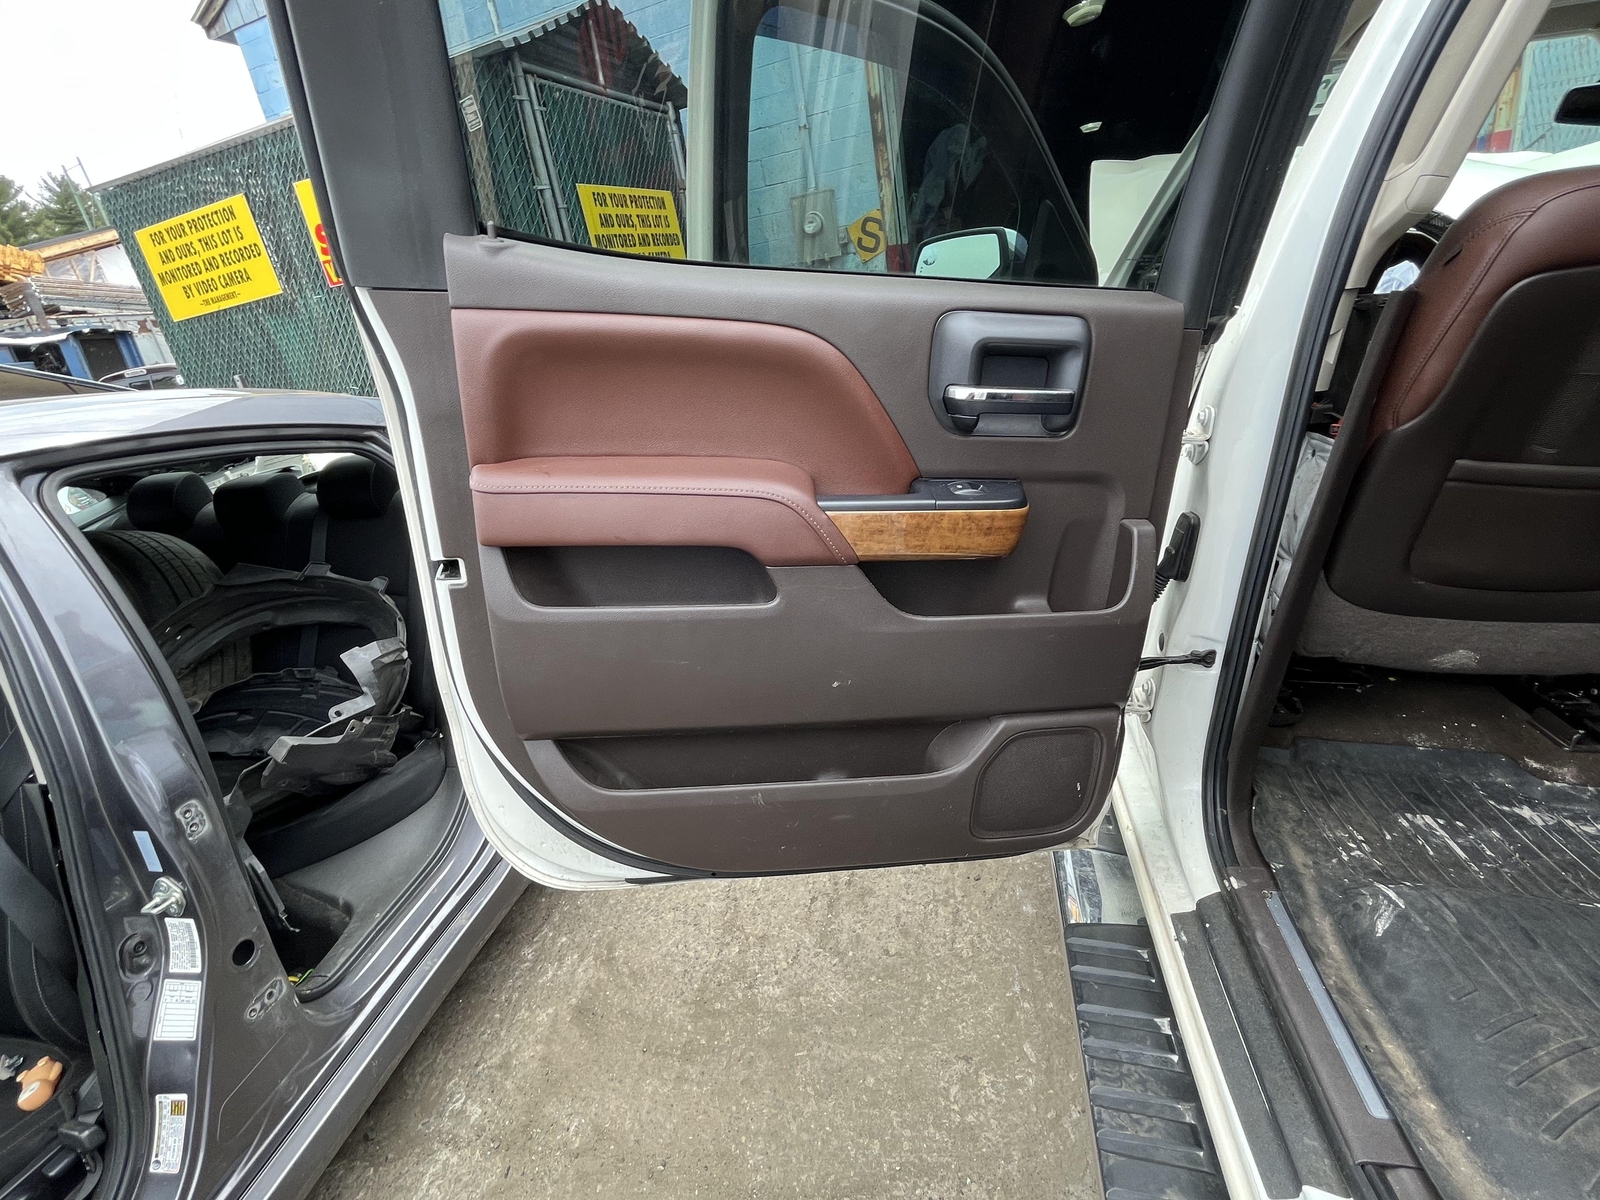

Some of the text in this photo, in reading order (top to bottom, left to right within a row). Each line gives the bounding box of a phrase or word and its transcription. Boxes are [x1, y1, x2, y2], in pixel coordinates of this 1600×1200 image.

[592, 191, 666, 210] FOR YOUR PROTECTION
[149, 205, 237, 247] FOR YOUR PROTECTION
[598, 213, 670, 231] AND OURS, THIS LOT IS
[857, 216, 884, 253] S
[158, 225, 244, 266] AND OURS, THIS LOT IS
[594, 233, 680, 249] MONITORED AND RECORDED
[157, 243, 262, 286] MONITORED AND RECORDED
[182, 268, 252, 300] BY VIDEO CAMERA
